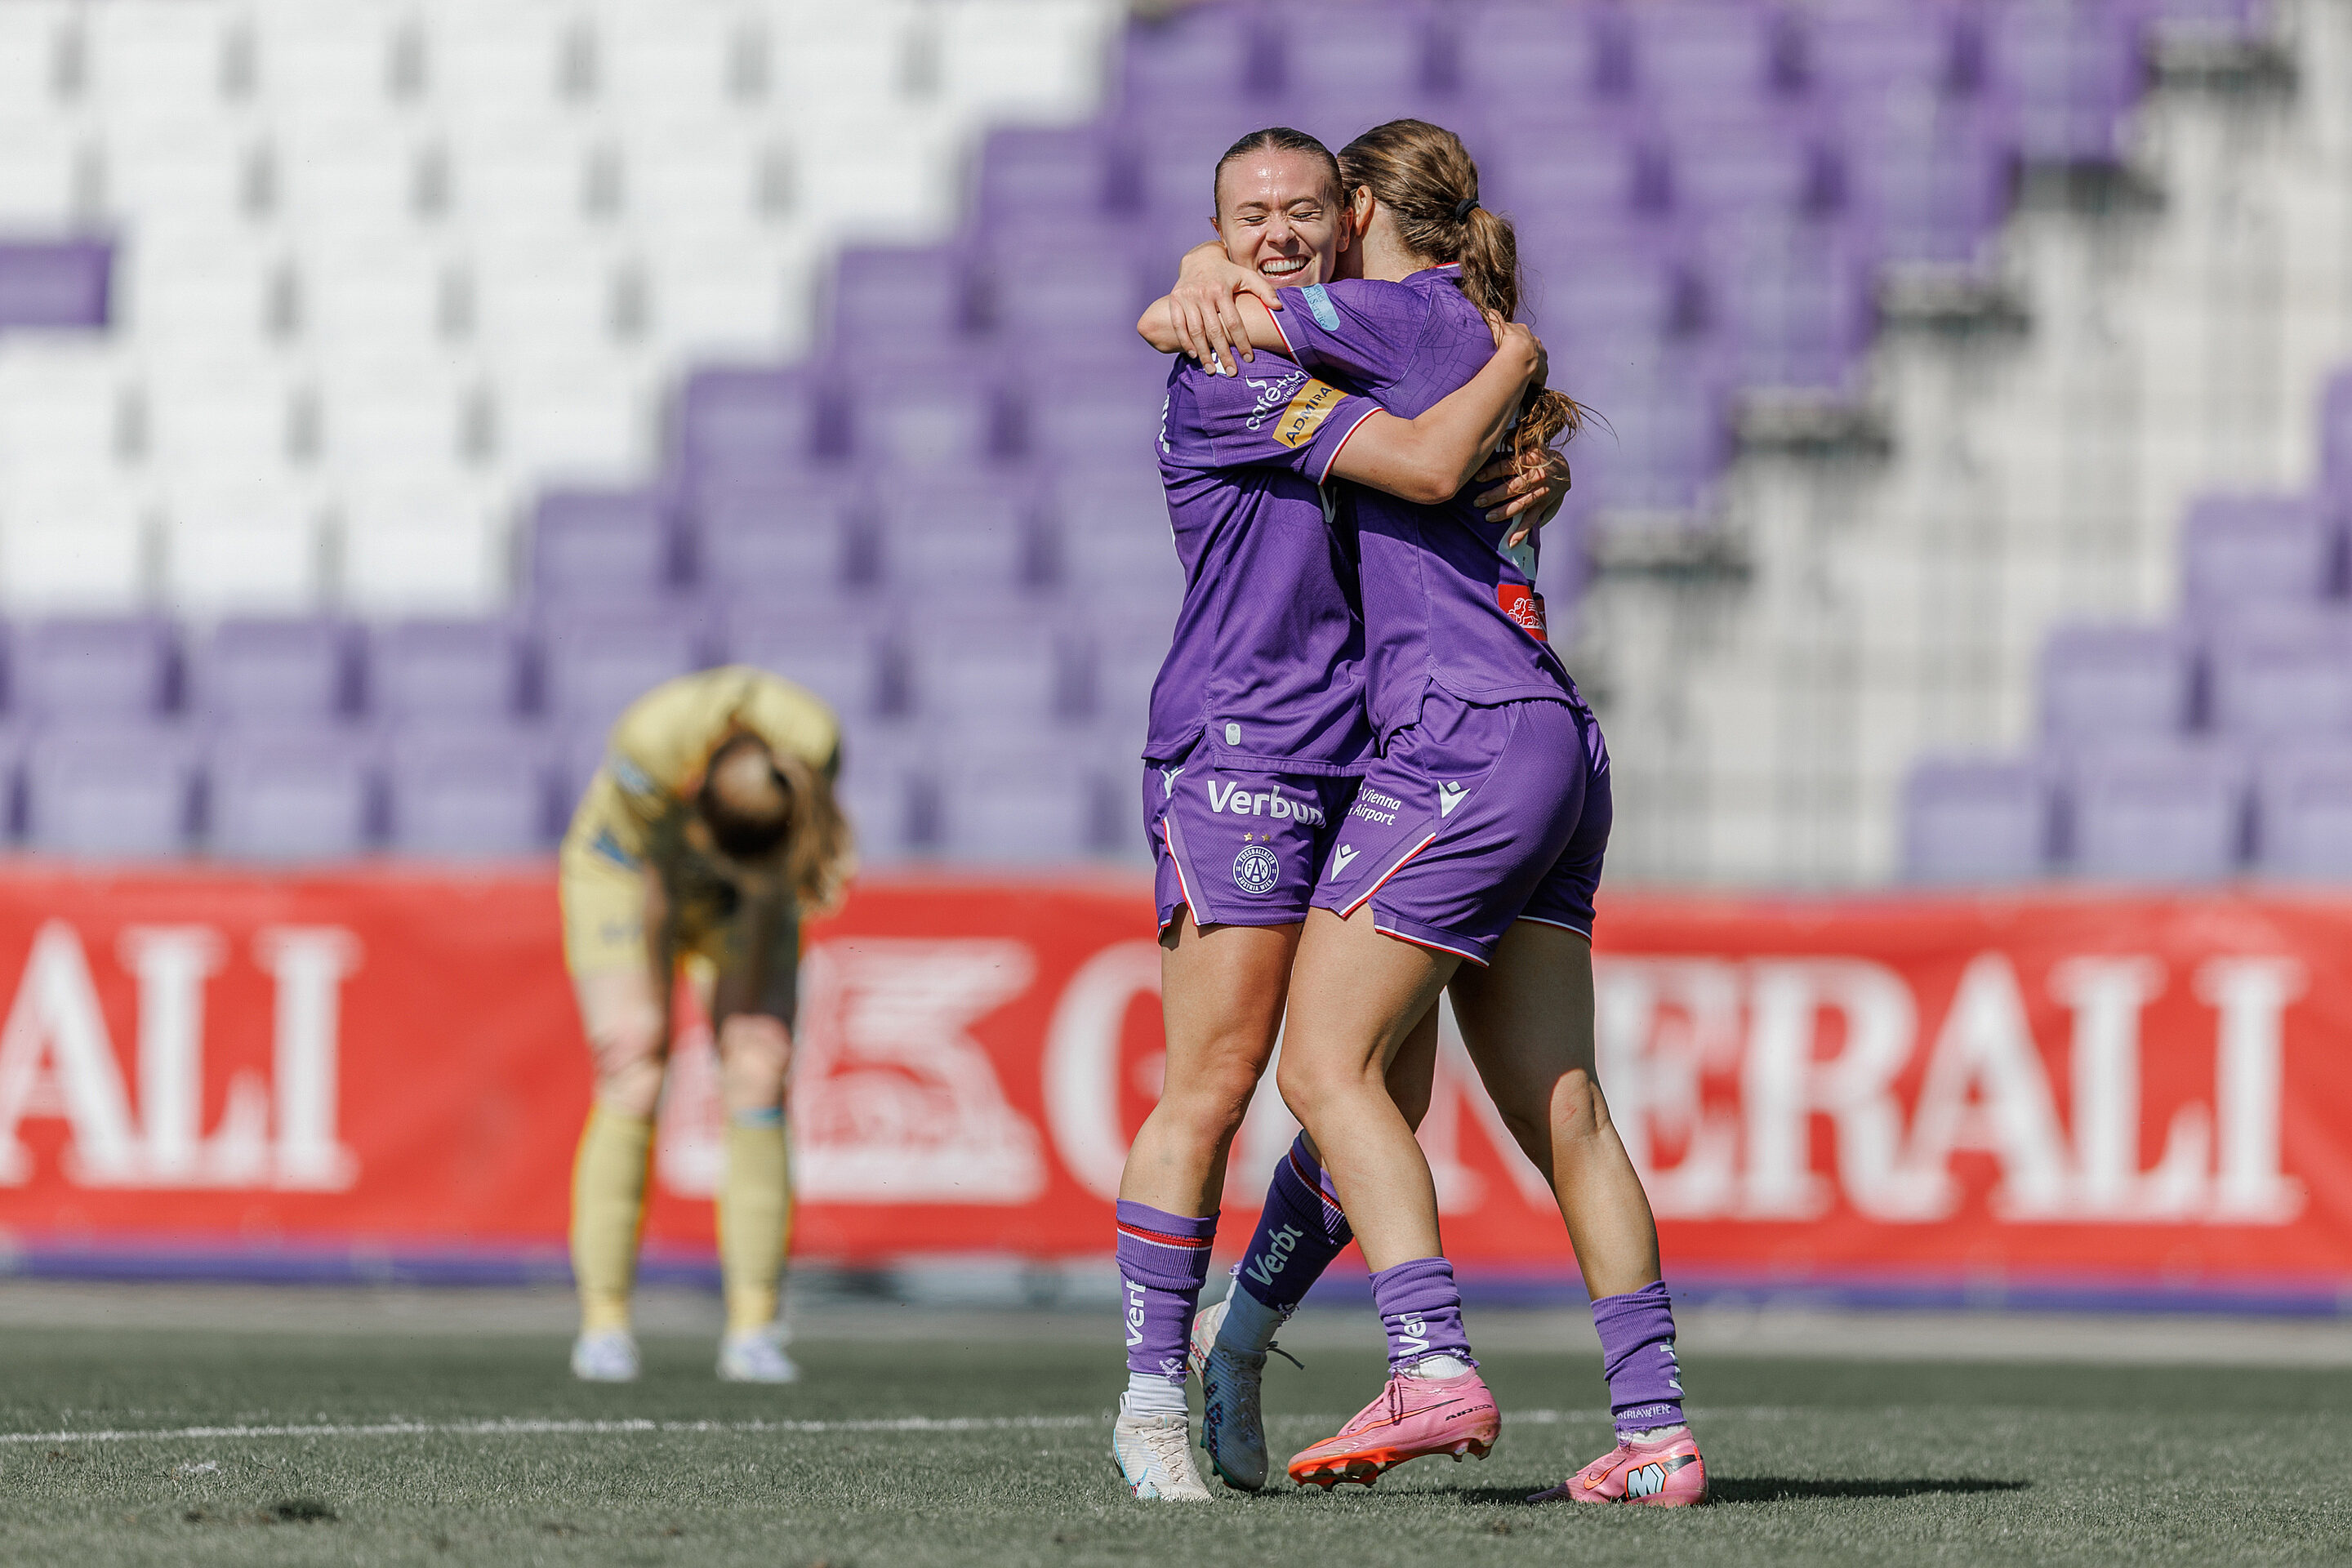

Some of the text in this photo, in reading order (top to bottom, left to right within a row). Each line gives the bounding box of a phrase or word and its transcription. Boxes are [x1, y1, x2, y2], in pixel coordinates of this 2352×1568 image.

[1285, 385, 1336, 446] ADMIRA
[1207, 780, 1326, 829] Verbun
[1352, 803, 1396, 826] Airport
[1361, 788, 1401, 811] Vienna
[1238, 849, 1276, 865] FUSSBALLKLUB
[1238, 876, 1273, 891] AUSTRIA WIEN
[1042, 939, 2307, 1224] GERALI
[1391, 1312, 1429, 1357] Ver
